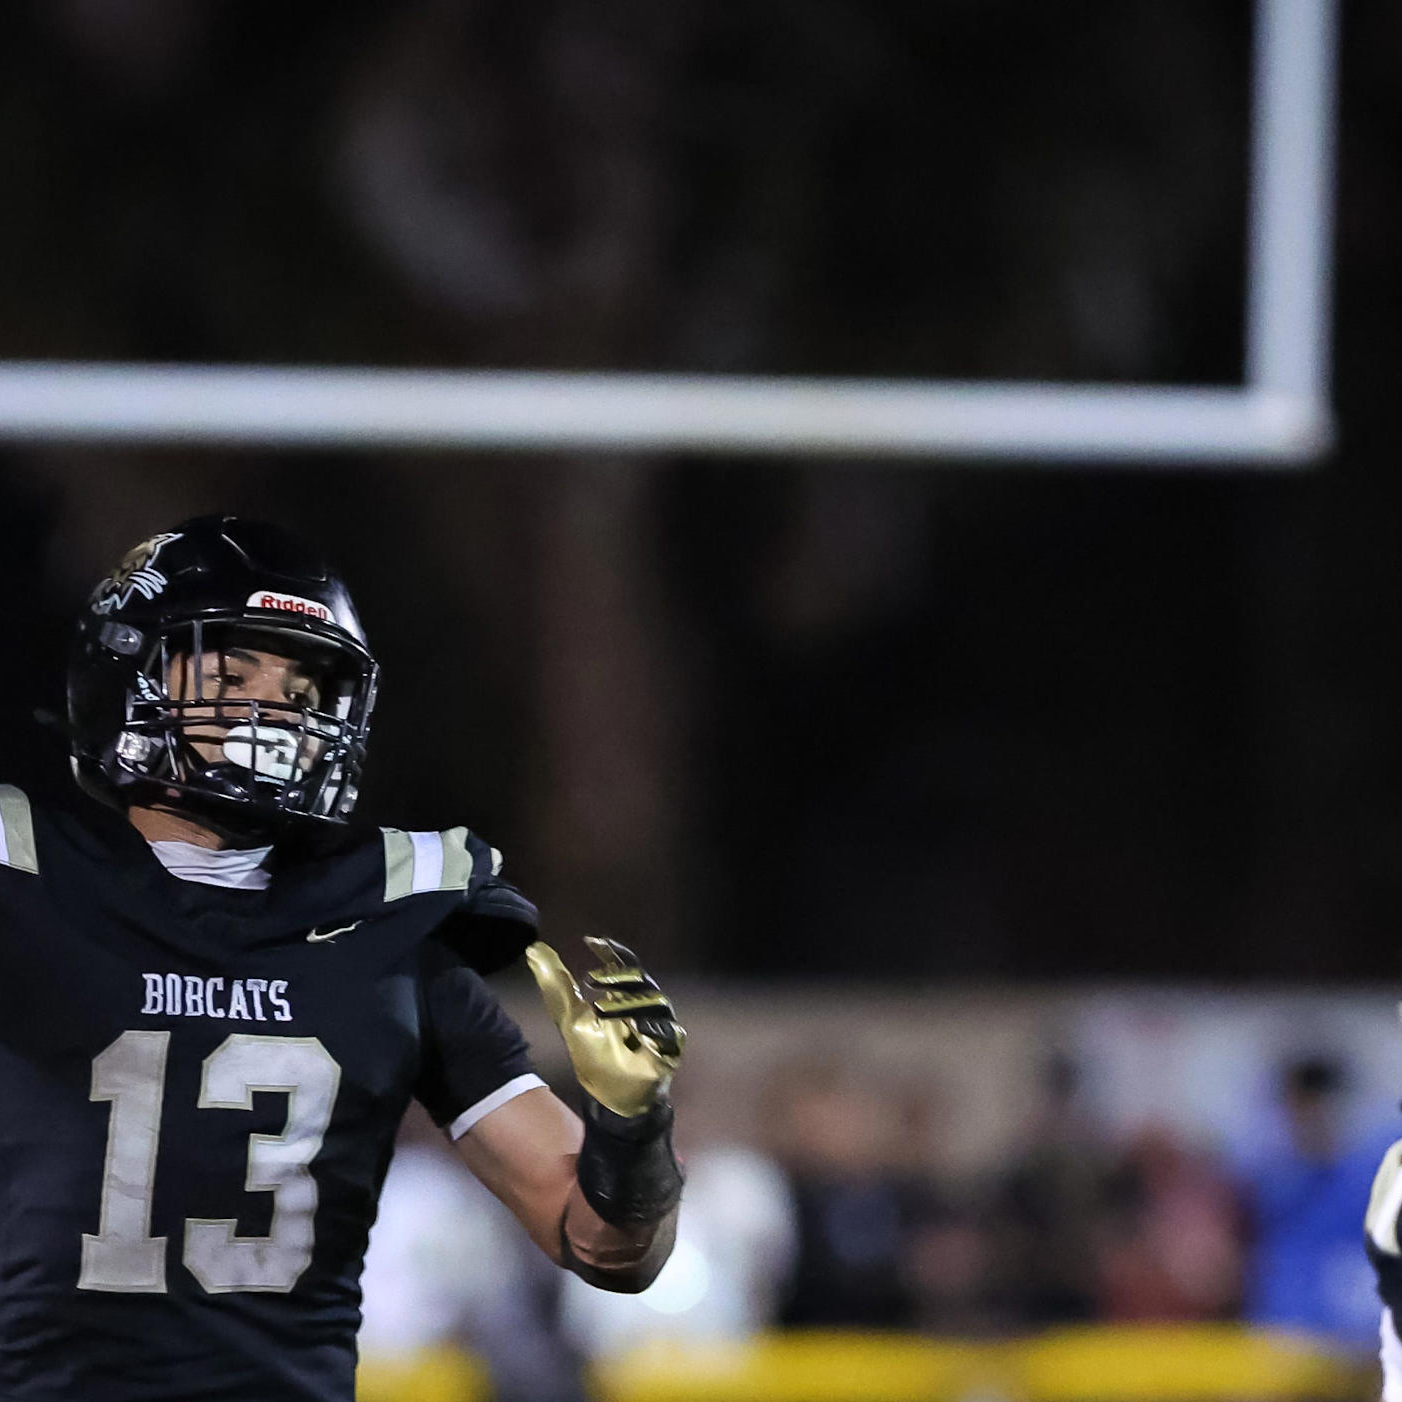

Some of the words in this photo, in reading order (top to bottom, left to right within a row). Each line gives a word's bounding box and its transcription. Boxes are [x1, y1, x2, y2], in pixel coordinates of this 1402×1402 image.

[261, 595, 328, 621] Riddell
[141, 973, 293, 1022] BOBCATS
[77, 1030, 342, 1294] 13
